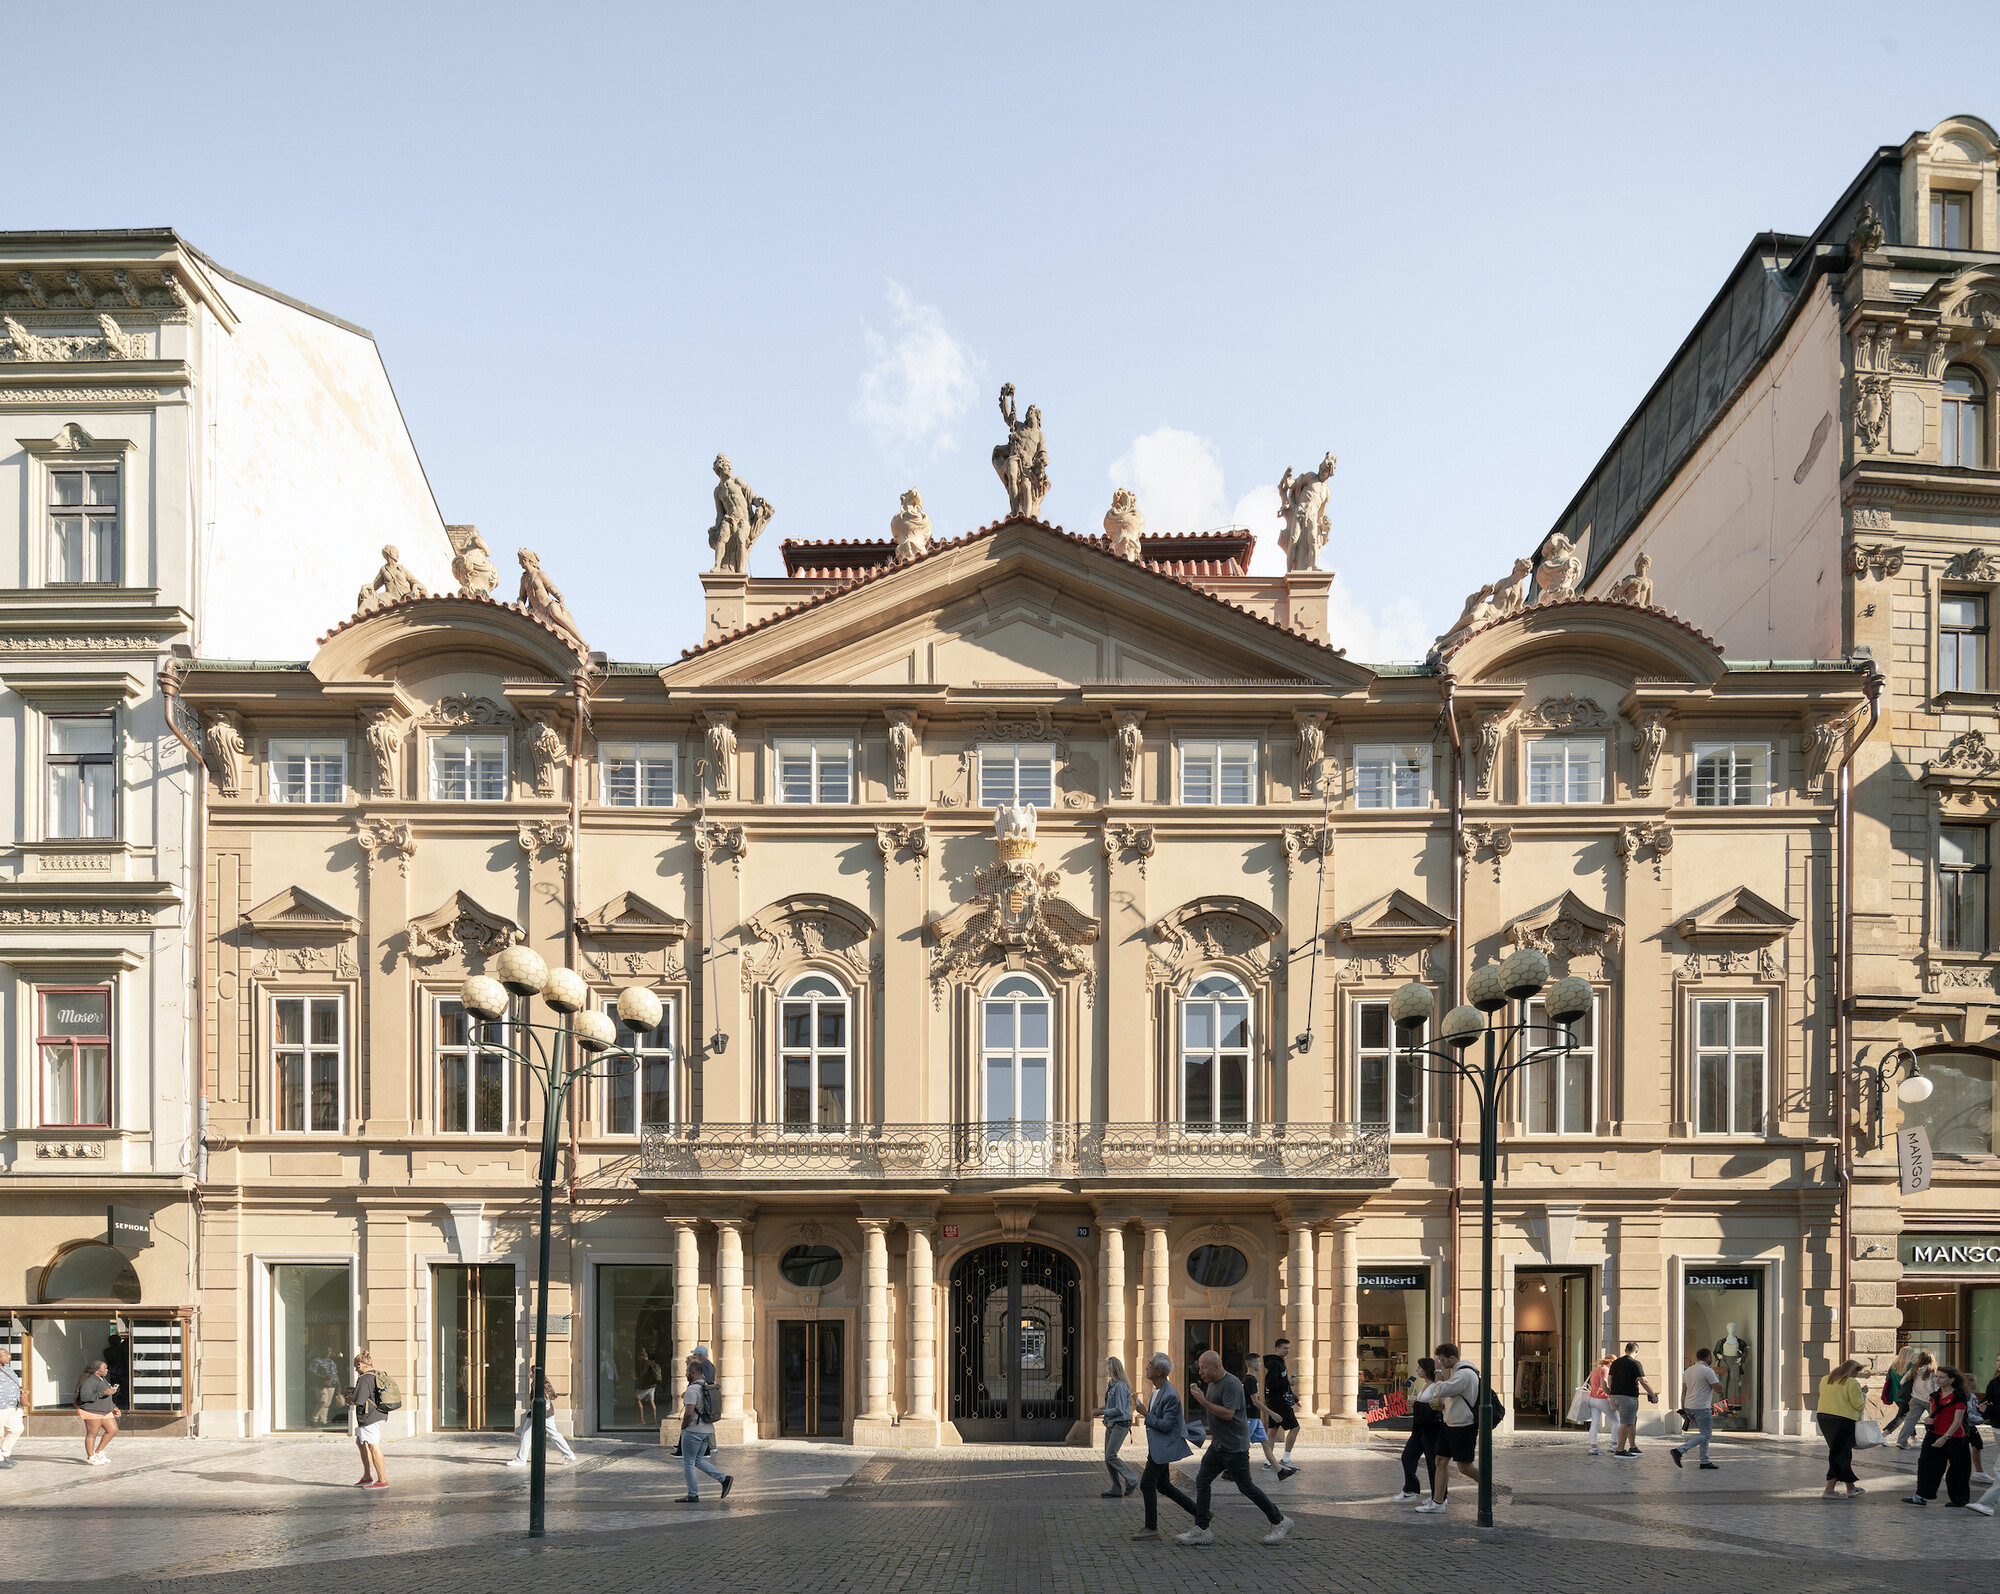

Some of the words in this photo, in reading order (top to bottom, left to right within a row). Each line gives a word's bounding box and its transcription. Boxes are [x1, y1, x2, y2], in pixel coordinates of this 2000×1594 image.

[57, 1009, 104, 1023] Moser
[1907, 1133, 1923, 1188] MANGO
[114, 1222, 149, 1232] SEPHORA
[1914, 1246, 2000, 1262] MANGO
[1358, 1276, 1417, 1285] Deliberti
[1689, 1276, 1748, 1285] Deliberti
[1383, 1390, 1407, 1406] LOVE
[1364, 1402, 1409, 1424] MOSCHINO
